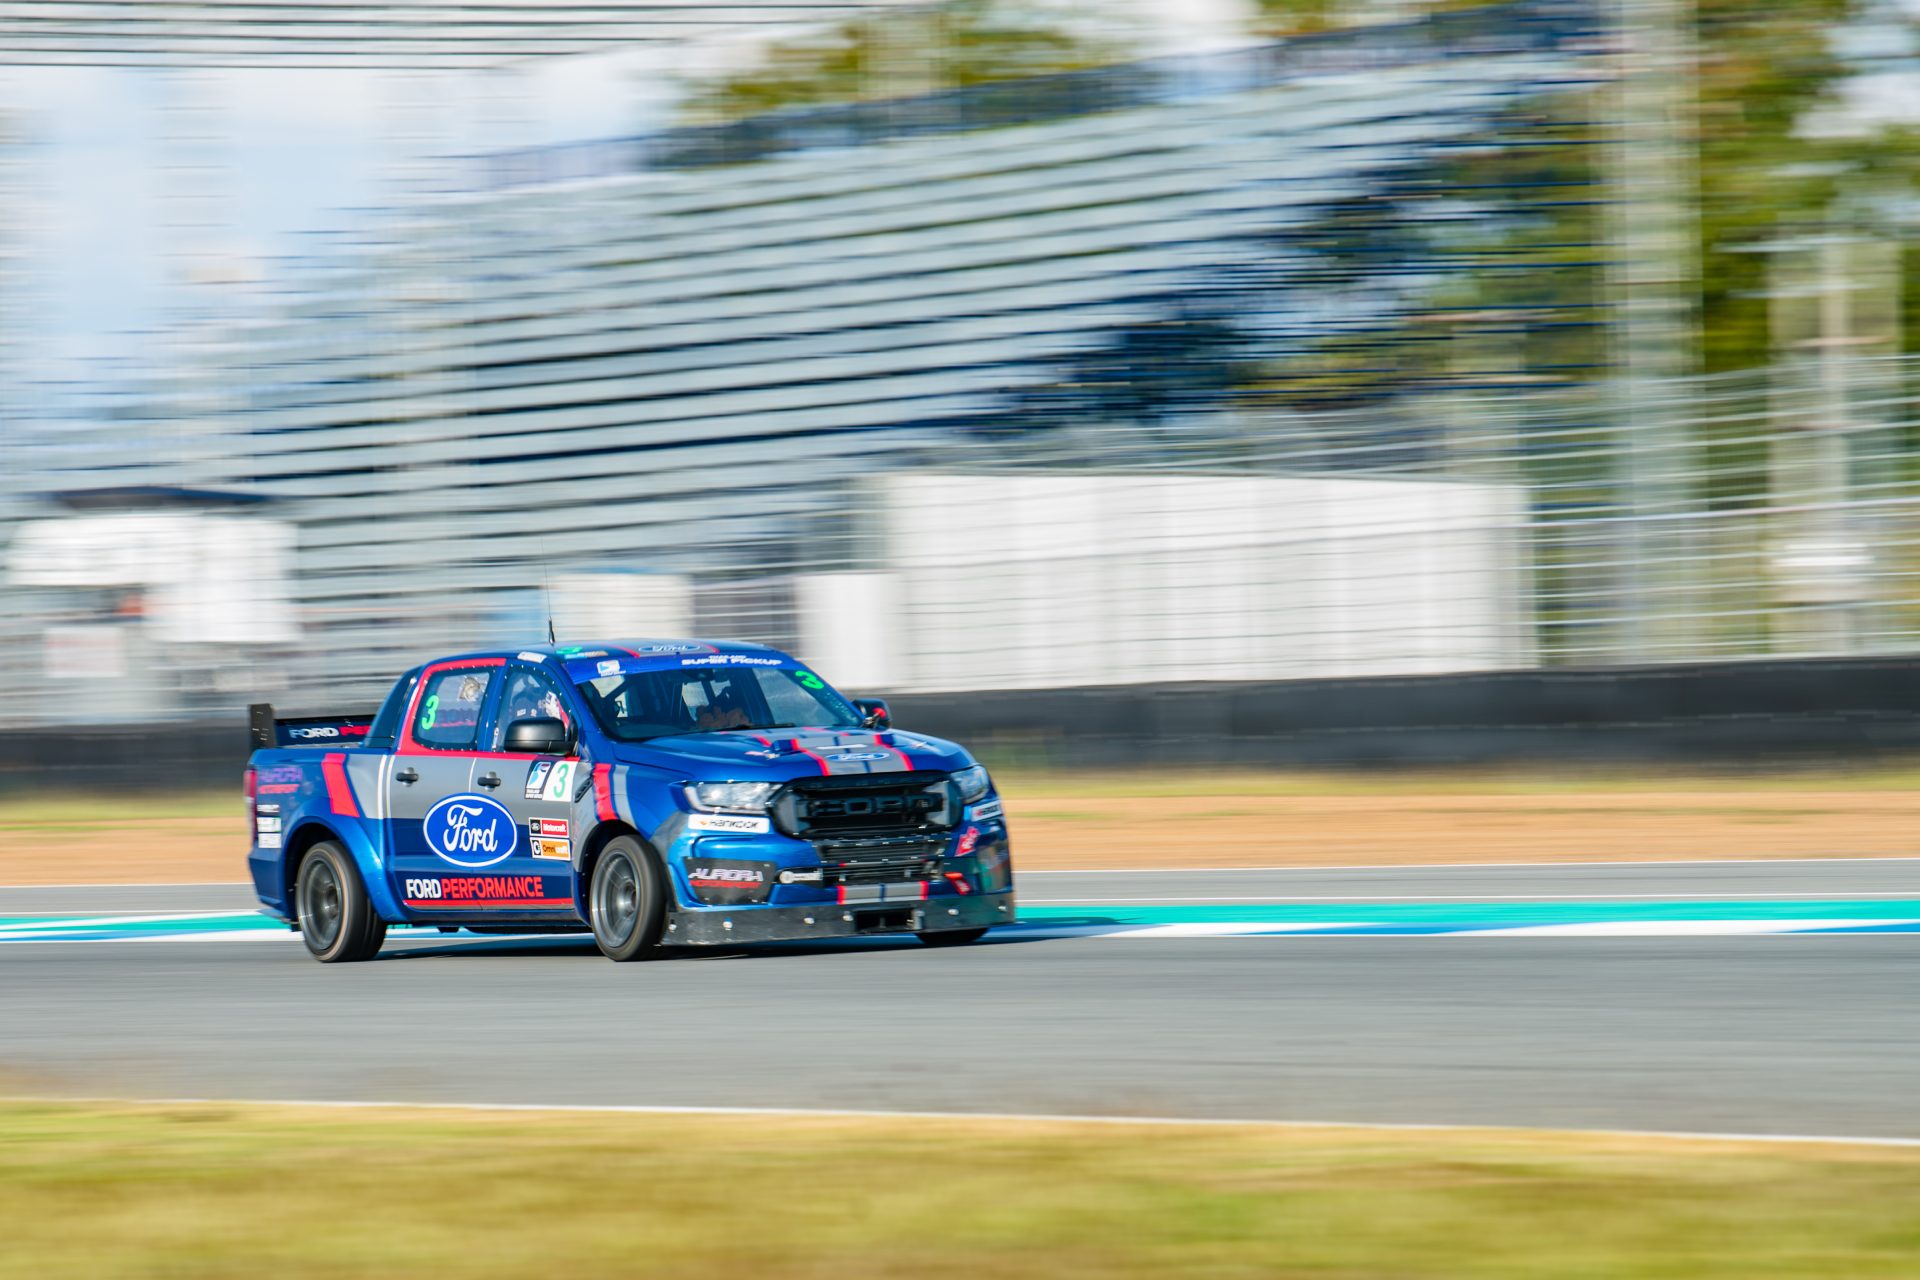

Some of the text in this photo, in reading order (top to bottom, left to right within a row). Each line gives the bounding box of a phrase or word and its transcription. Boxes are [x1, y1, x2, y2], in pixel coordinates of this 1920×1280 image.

[795, 670, 825, 689] 3
[421, 695, 439, 730] 3
[289, 727, 339, 738] FORD
[553, 763, 569, 798] 3
[443, 804, 498, 852] Ford
[405, 876, 544, 899] FORD PERFORMANCE
